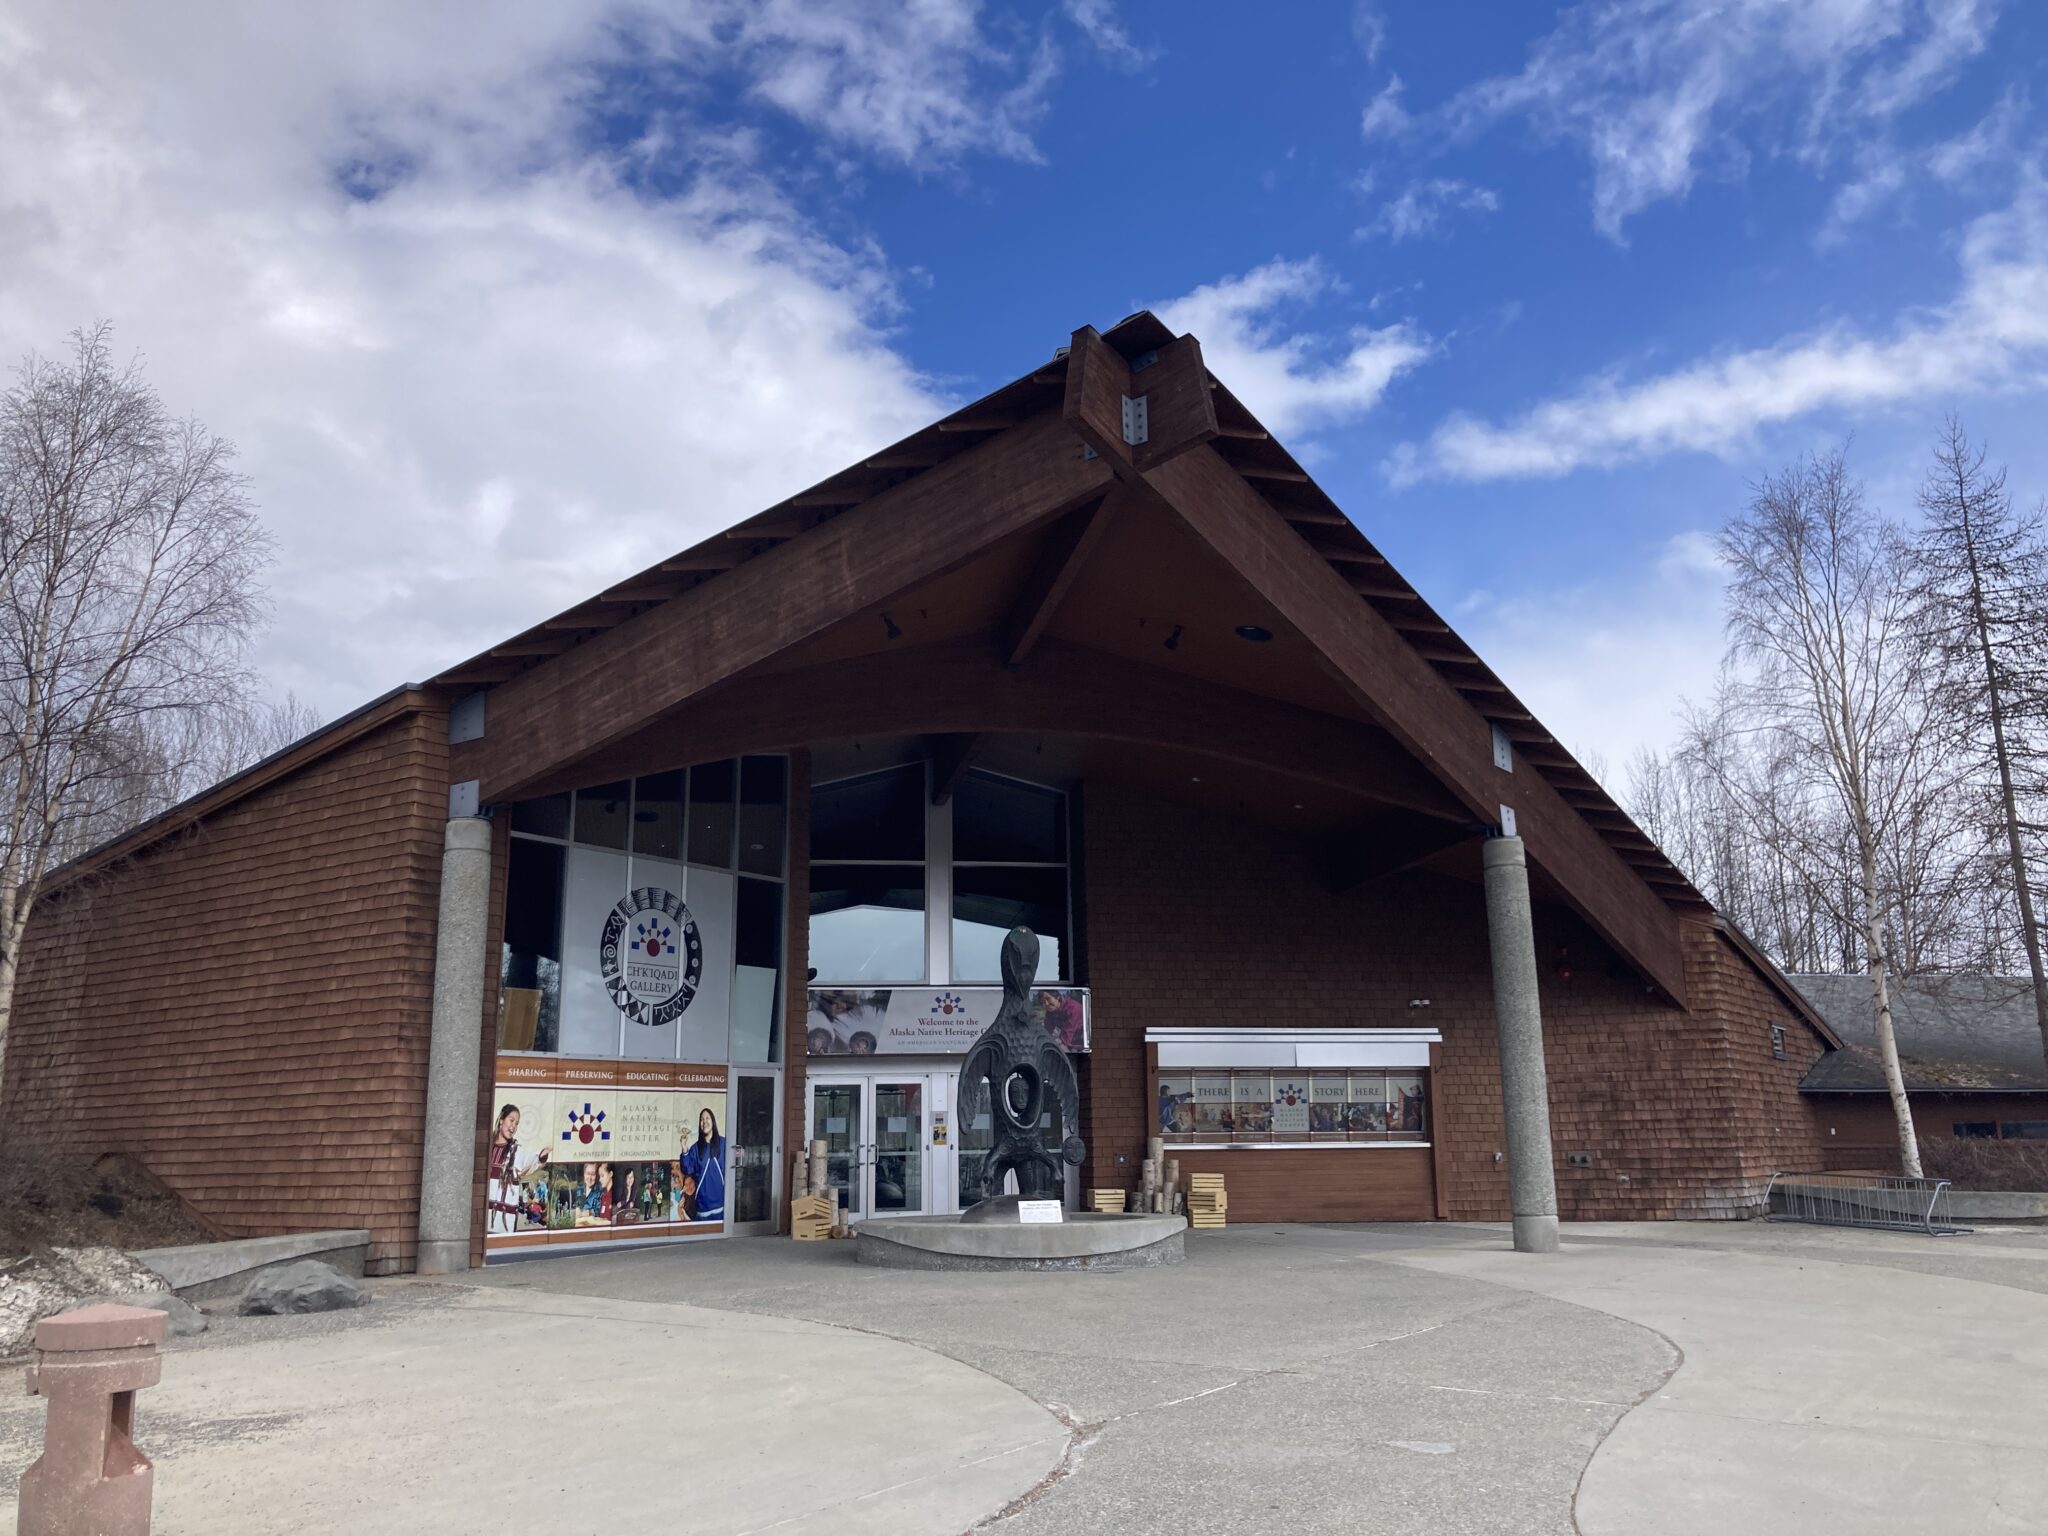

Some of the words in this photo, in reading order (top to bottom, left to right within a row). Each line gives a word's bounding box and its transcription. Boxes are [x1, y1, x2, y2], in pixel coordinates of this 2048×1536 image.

[630, 981, 673, 993] GALLERY
[918, 1018, 955, 1026] Welcome
[956, 1018, 963, 1026] to
[966, 1017, 979, 1026] the
[889, 1028, 915, 1036] Alaska
[917, 1028, 943, 1036] Native
[945, 1028, 979, 1038] Heritage
[507, 1068, 547, 1077] SHARING
[565, 1070, 614, 1080] PRESERVING
[626, 1072, 670, 1081] EDUCATING
[679, 1074, 725, 1083] CELEBRATING
[1198, 1087, 1230, 1097] THERE
[1240, 1087, 1249, 1096] IS
[1255, 1087, 1264, 1096] A
[1314, 1087, 1345, 1096] STORY
[1355, 1087, 1380, 1096] HERE
